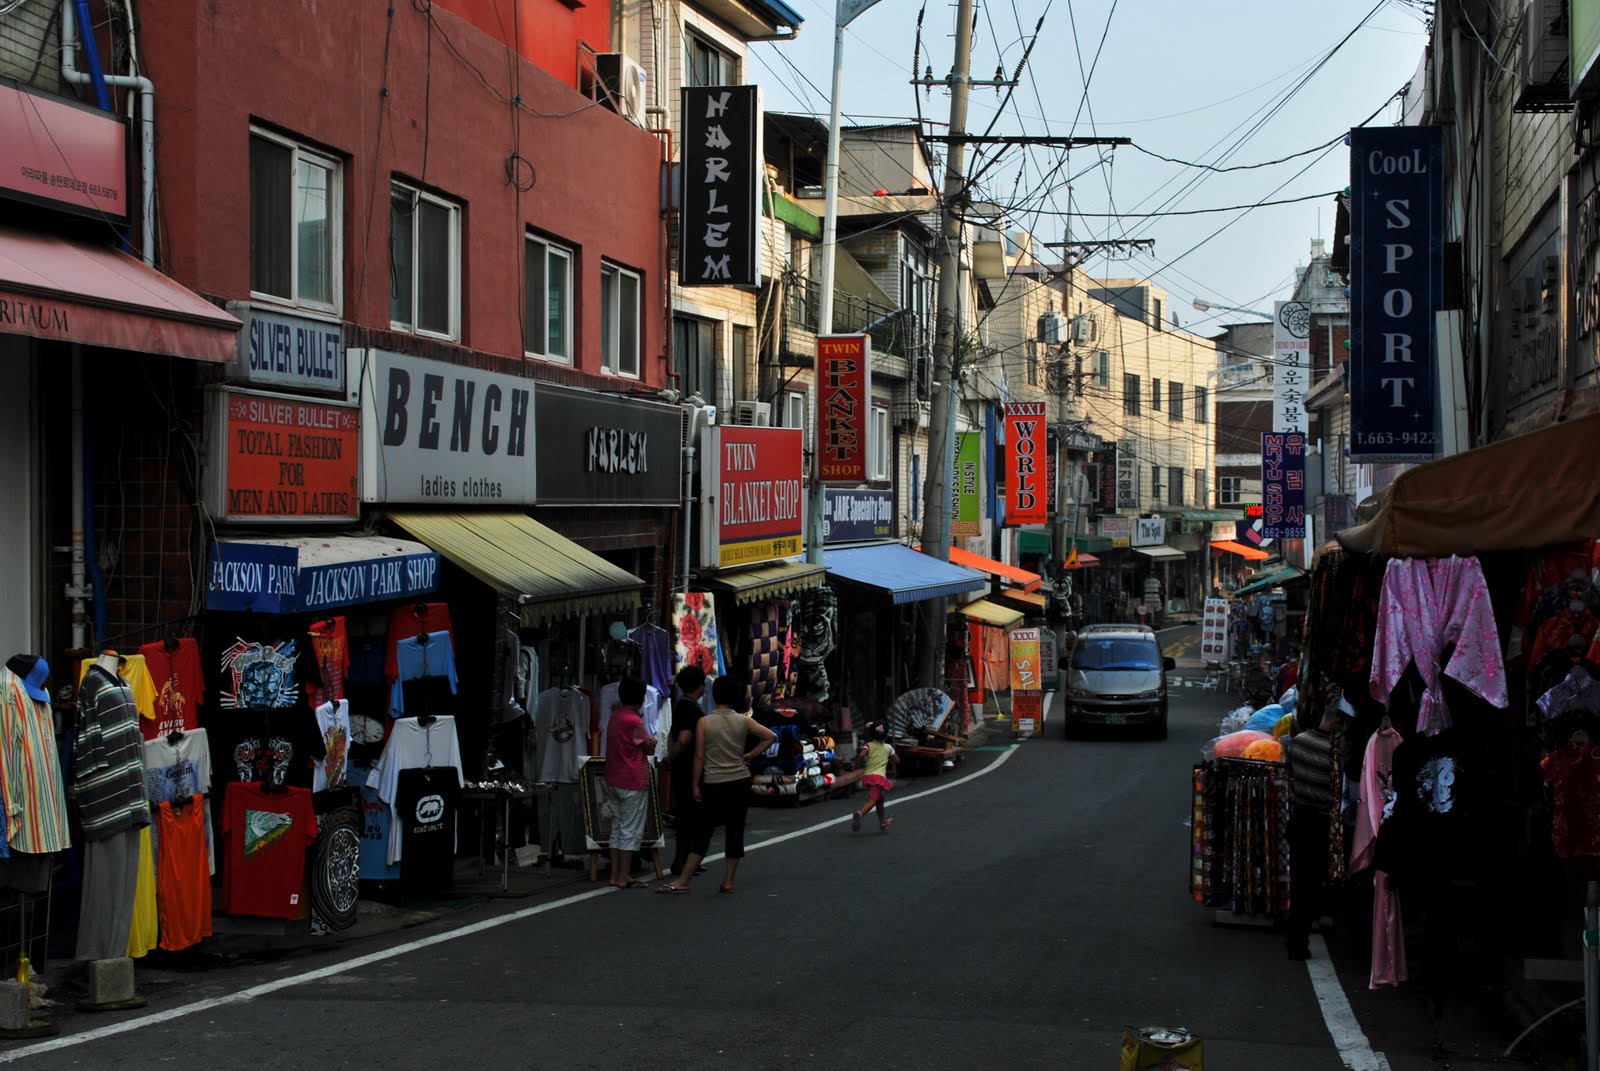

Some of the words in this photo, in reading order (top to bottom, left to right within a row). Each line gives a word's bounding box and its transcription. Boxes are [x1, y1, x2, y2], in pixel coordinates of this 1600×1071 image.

[701, 91, 732, 280] HARLEM
[1379, 199, 1416, 408] SPORT
[250, 317, 292, 374] SILVER
[297, 327, 340, 379] BULLET
[822, 343, 860, 354] TWIN
[250, 401, 292, 424] SILVER
[298, 409, 341, 428] BULLET
[383, 367, 529, 457] BENCH
[825, 358, 858, 462] BLANKET
[1007, 403, 1045, 416] XXXL
[238, 429, 283, 457] TOTAL
[288, 433, 343, 461] FASHION
[585, 426, 647, 474] HARLEM
[726, 443, 757, 472] TWIN
[279, 462, 304, 486] FOR
[822, 464, 861, 476] SHOP
[1013, 420, 1037, 510] WORLD
[229, 488, 263, 514] MEN
[266, 490, 299, 514] AND
[302, 492, 349, 515] LADIES
[420, 474, 456, 497] ladies
[463, 477, 502, 498] clothes
[722, 482, 773, 526] BLANKET
[774, 479, 800, 520] SHOP
[833, 495, 850, 522] JADE
[878, 496, 892, 525] Shop
[1265, 483, 1284, 526] SHOP
[1264, 527, 1305, 538] 662-9855
[209, 561, 263, 593] JACKSON
[268, 564, 297, 596] PARK
[306, 565, 366, 607] JACKSON
[370, 561, 402, 595] PARK
[407, 557, 436, 591] SHOP
[1013, 631, 1036, 641] XXXL
[1015, 659, 1036, 690] SAL
